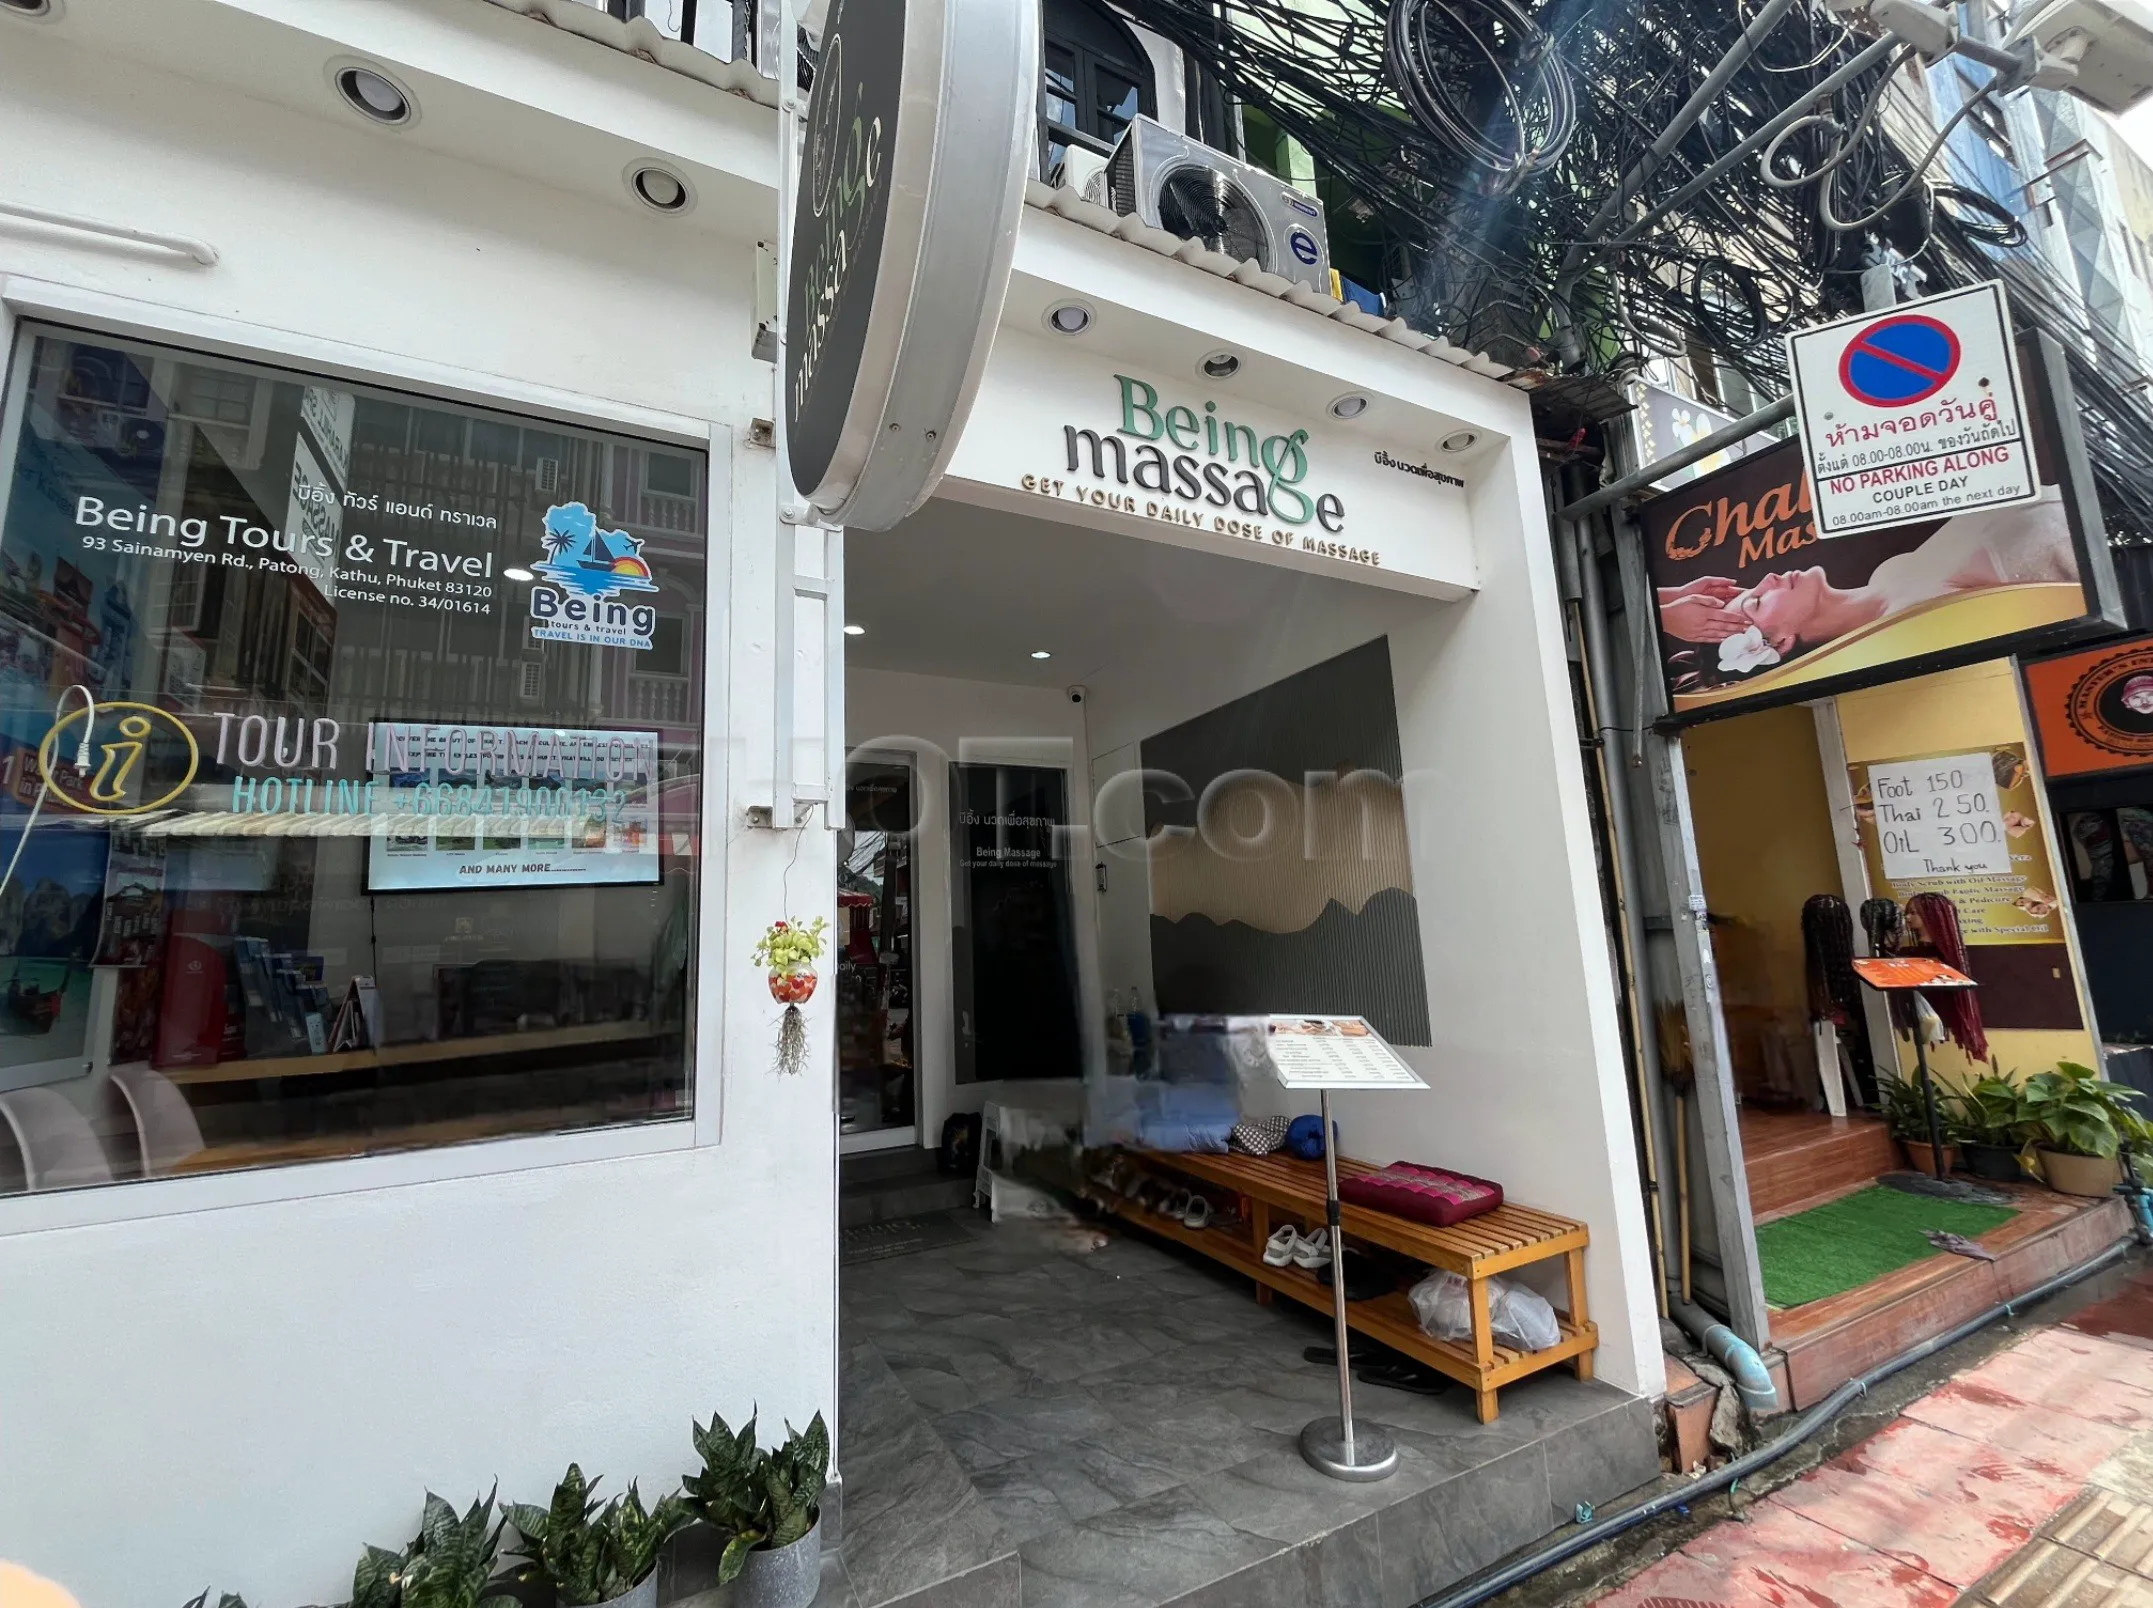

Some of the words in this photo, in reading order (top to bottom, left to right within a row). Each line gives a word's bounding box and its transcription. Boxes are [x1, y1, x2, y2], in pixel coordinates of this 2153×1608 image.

[1825, 392, 1998, 448] ห้ามจอดวันคู่
[1113, 373, 1314, 525] Being
[1063, 424, 1345, 534] massage
[1830, 479, 1855, 495] NO
[1860, 460, 1938, 489] PARKING
[1943, 446, 2009, 473] ALONG
[1873, 482, 1934, 503] COUPLE
[1938, 475, 1969, 492] DAY
[1943, 495, 1961, 507] the
[1966, 489, 1992, 502] next
[1997, 485, 2021, 499] day
[343, 491, 379, 511] ทัวร์
[386, 501, 434, 519] แอนด์
[441, 509, 497, 530] ทราเวล
[1022, 473, 1064, 497] GET
[1076, 485, 1136, 513] YOUR
[1147, 501, 1204, 527] DAILY
[1214, 516, 1262, 540] DOSE
[1272, 530, 1295, 546] OF
[1303, 536, 1380, 566] MASSAGE
[75, 496, 207, 547] Being
[219, 515, 333, 557] Tours
[345, 534, 374, 563] &
[383, 538, 493, 578] Travel
[82, 536, 106, 550] 93
[112, 539, 216, 563] Sainamyen
[222, 553, 253, 570] Rd.,
[259, 558, 324, 579] Patong,
[329, 566, 381, 586] Kathu,
[387, 573, 442, 591] Phuket
[446, 579, 492, 597] 83120
[324, 584, 385, 603] License
[390, 594, 414, 606] no.
[419, 596, 491, 615] 34/01614
[533, 588, 652, 636] Being
[534, 629, 572, 640] TRAVEL
[590, 634, 600, 643] IN
[604, 636, 626, 645] OUR
[630, 638, 651, 648] DNA
[550, 622, 579, 630] tours
[584, 624, 591, 632] &
[596, 625, 626, 635] travel
[214, 711, 340, 770] TOUR
[366, 721, 655, 783] INFORMATION
[1877, 775, 1913, 799] Foot
[1927, 769, 1963, 793] 150
[1877, 803, 1921, 823] Thai
[459, 865, 482, 874] AND
[486, 864, 517, 874] MANY
[976, 846, 1001, 859] Being
[1004, 847, 1041, 860] Massage
[1923, 857, 1961, 873] Thank
[1964, 863, 1988, 874] you
